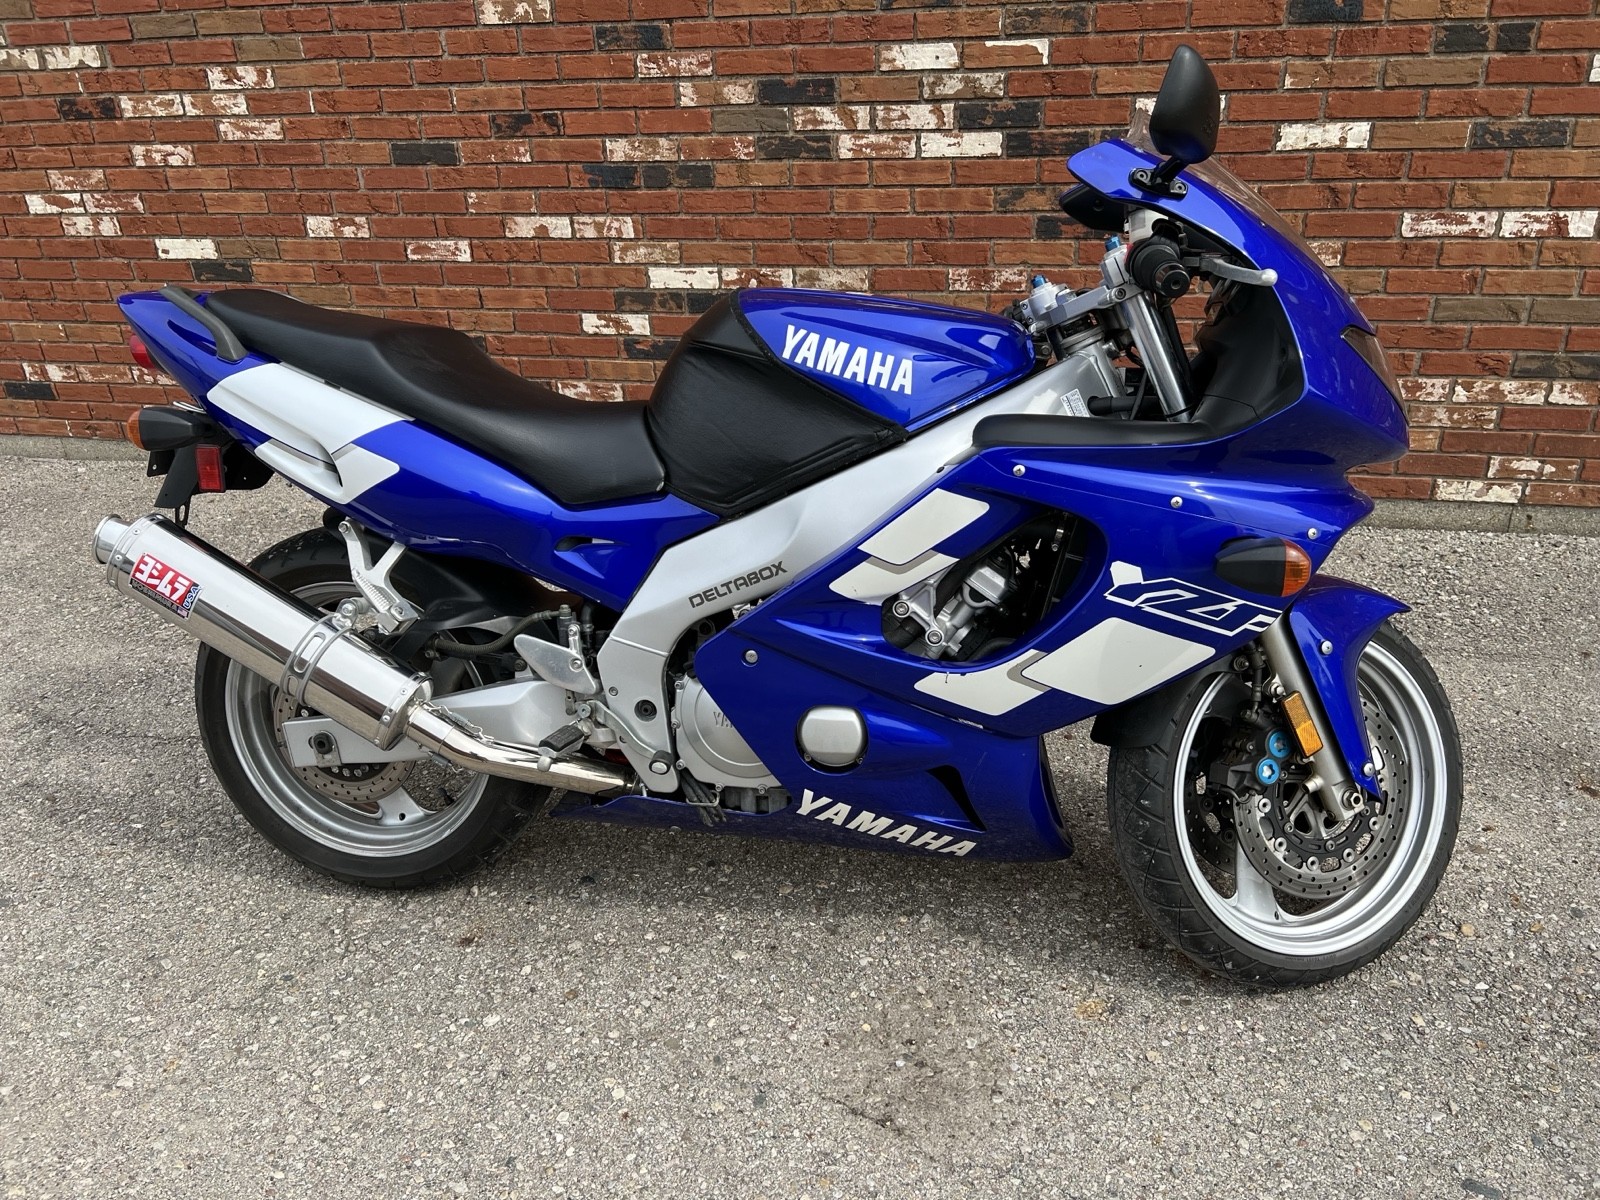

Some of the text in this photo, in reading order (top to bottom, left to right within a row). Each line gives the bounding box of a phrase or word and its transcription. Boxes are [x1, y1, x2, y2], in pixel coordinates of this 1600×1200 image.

[782, 325, 913, 395] YAMAHA
[135, 556, 190, 601] ヨシムラ
[183, 586, 199, 609] USA
[688, 561, 788, 608] DELTABOX
[796, 788, 977, 857] YAMAHA
